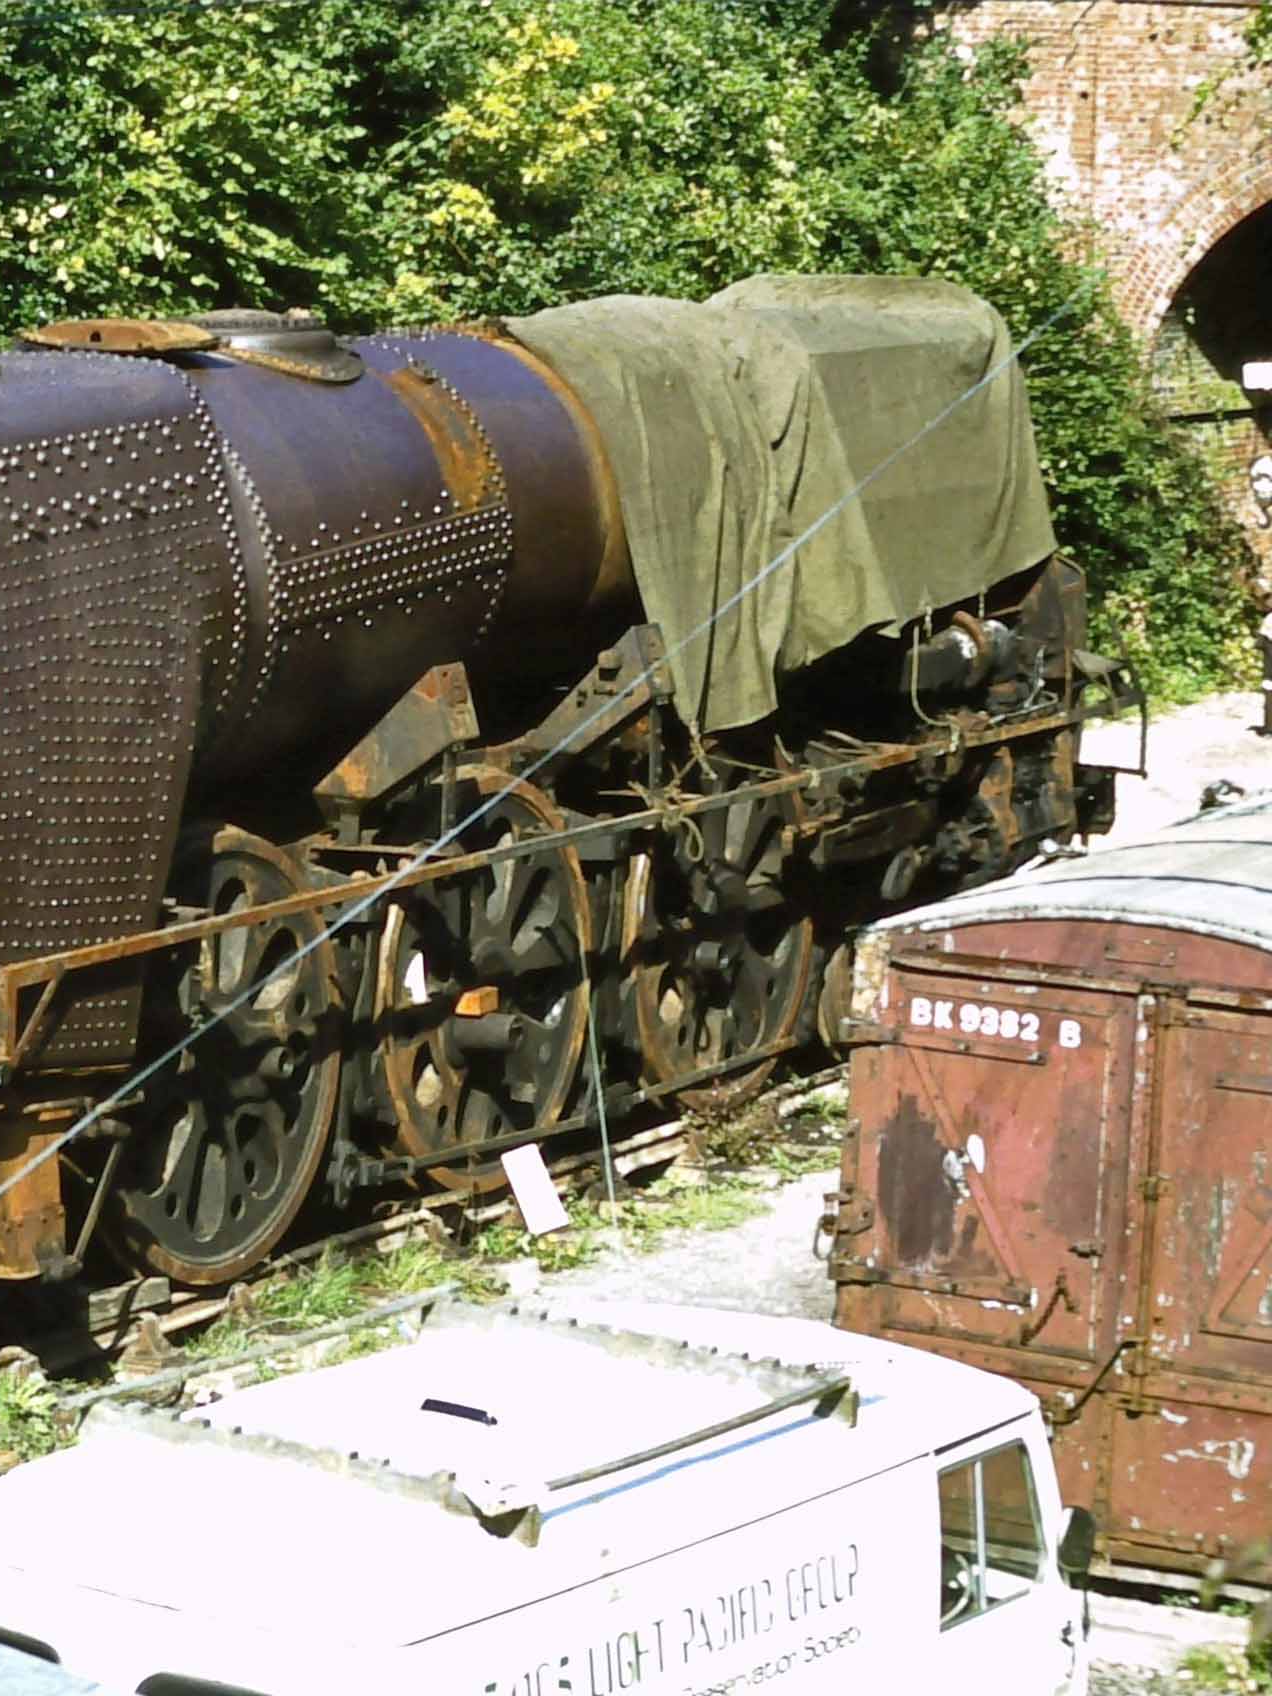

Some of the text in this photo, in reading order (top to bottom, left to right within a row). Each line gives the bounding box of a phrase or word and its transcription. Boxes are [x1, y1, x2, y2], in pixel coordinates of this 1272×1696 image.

[910, 997, 1082, 1049] BK 9382 B
[588, 1618, 665, 1696] LIGHT
